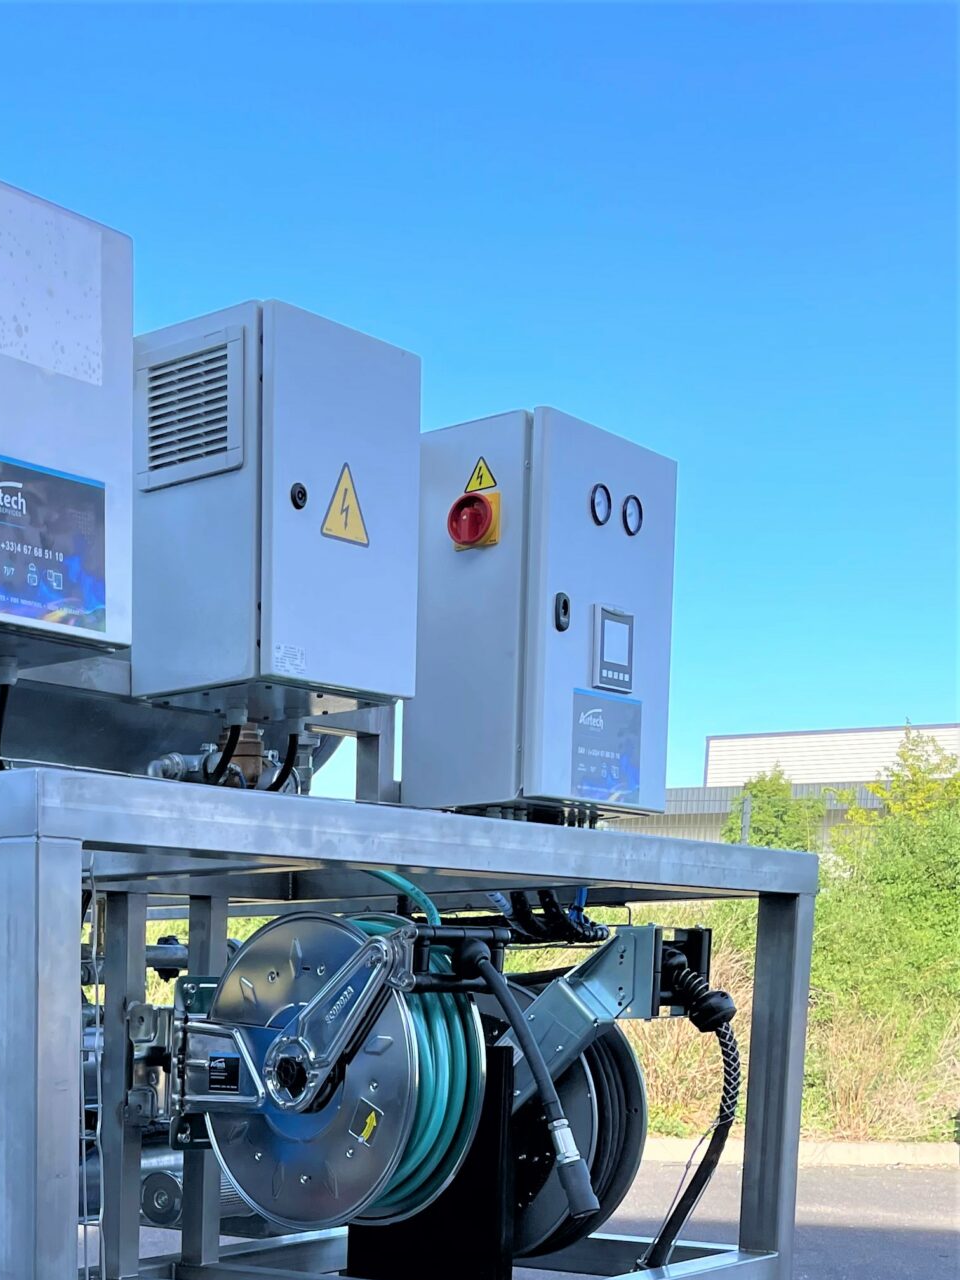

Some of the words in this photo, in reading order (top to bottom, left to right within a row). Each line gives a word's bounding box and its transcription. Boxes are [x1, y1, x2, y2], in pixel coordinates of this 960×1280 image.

[23, 544, 32, 555] 67
[44, 549, 53, 560] 51
[55, 551, 64, 562] 10
[579, 708, 604, 730] Airtech
